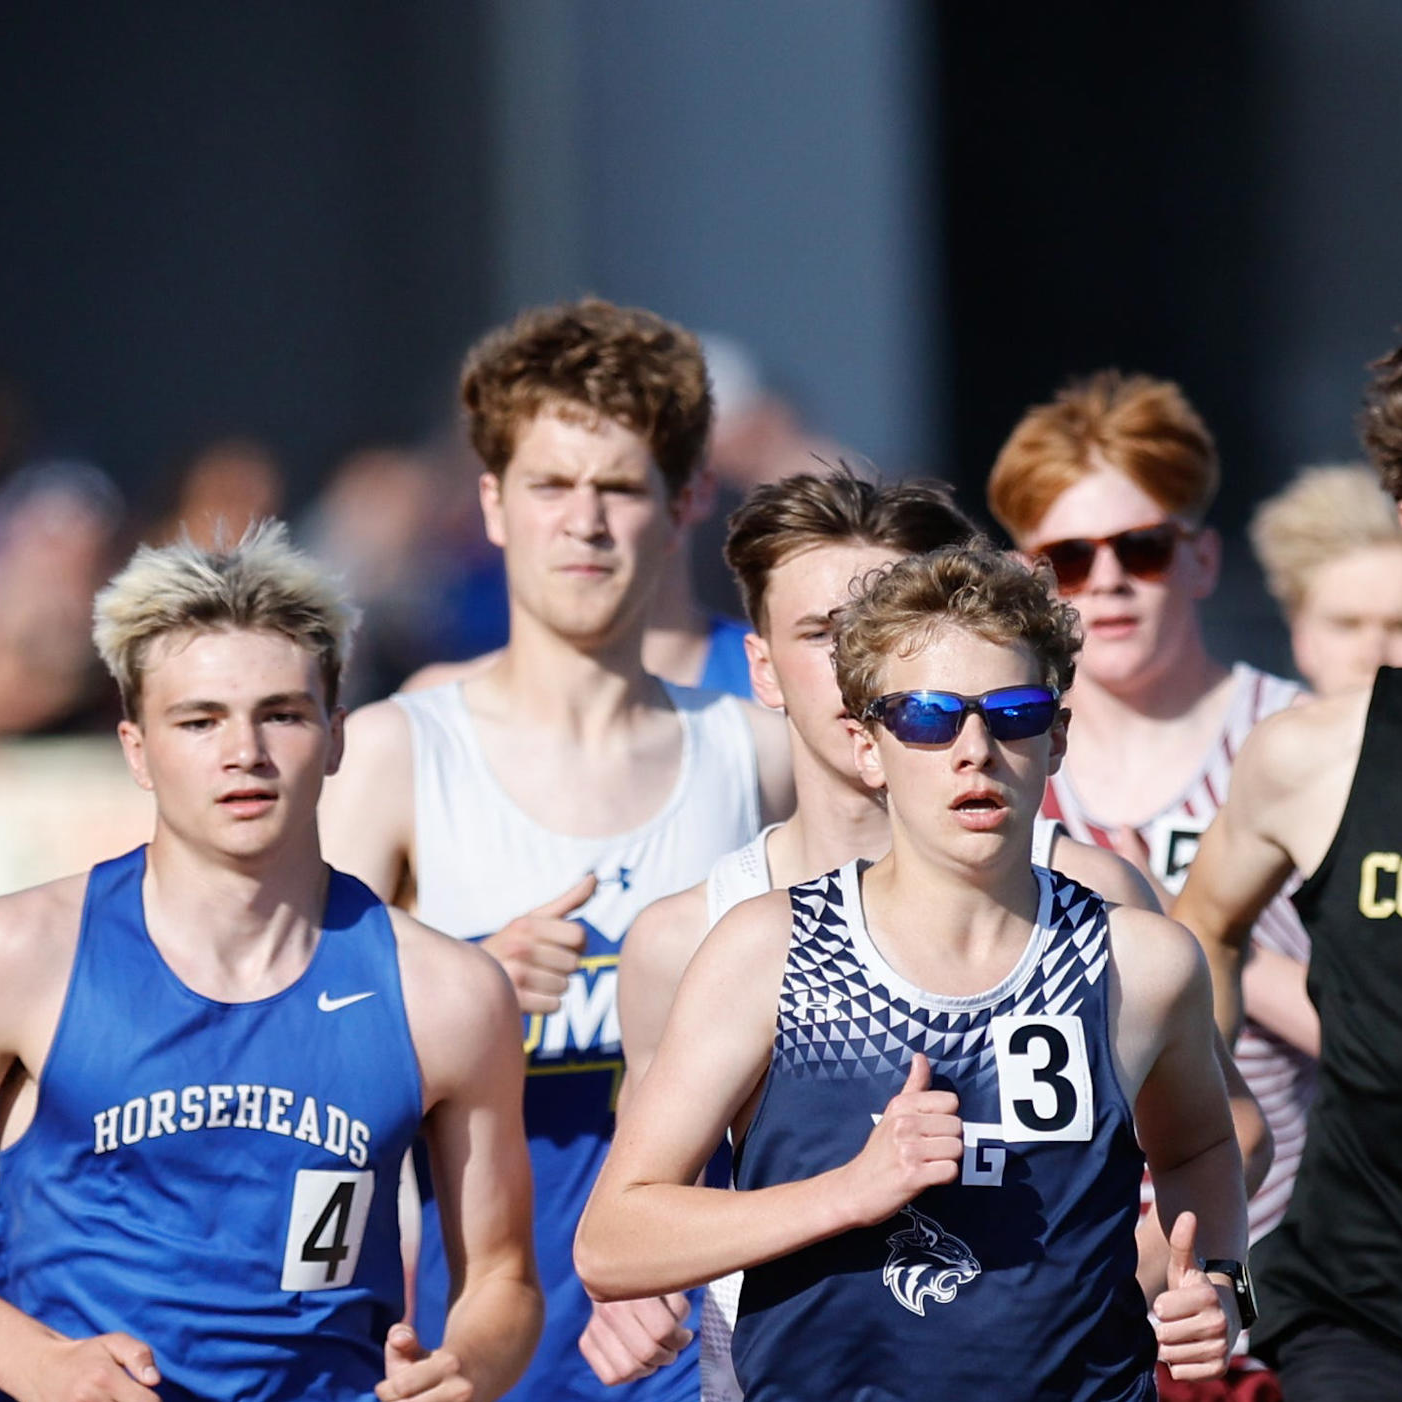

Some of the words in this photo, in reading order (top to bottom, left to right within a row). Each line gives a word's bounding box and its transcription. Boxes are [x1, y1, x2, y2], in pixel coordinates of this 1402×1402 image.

[94, 1084, 371, 1169] HORSEHEADS
[1008, 1023, 1078, 1132] 3
[300, 1181, 356, 1283] 4
